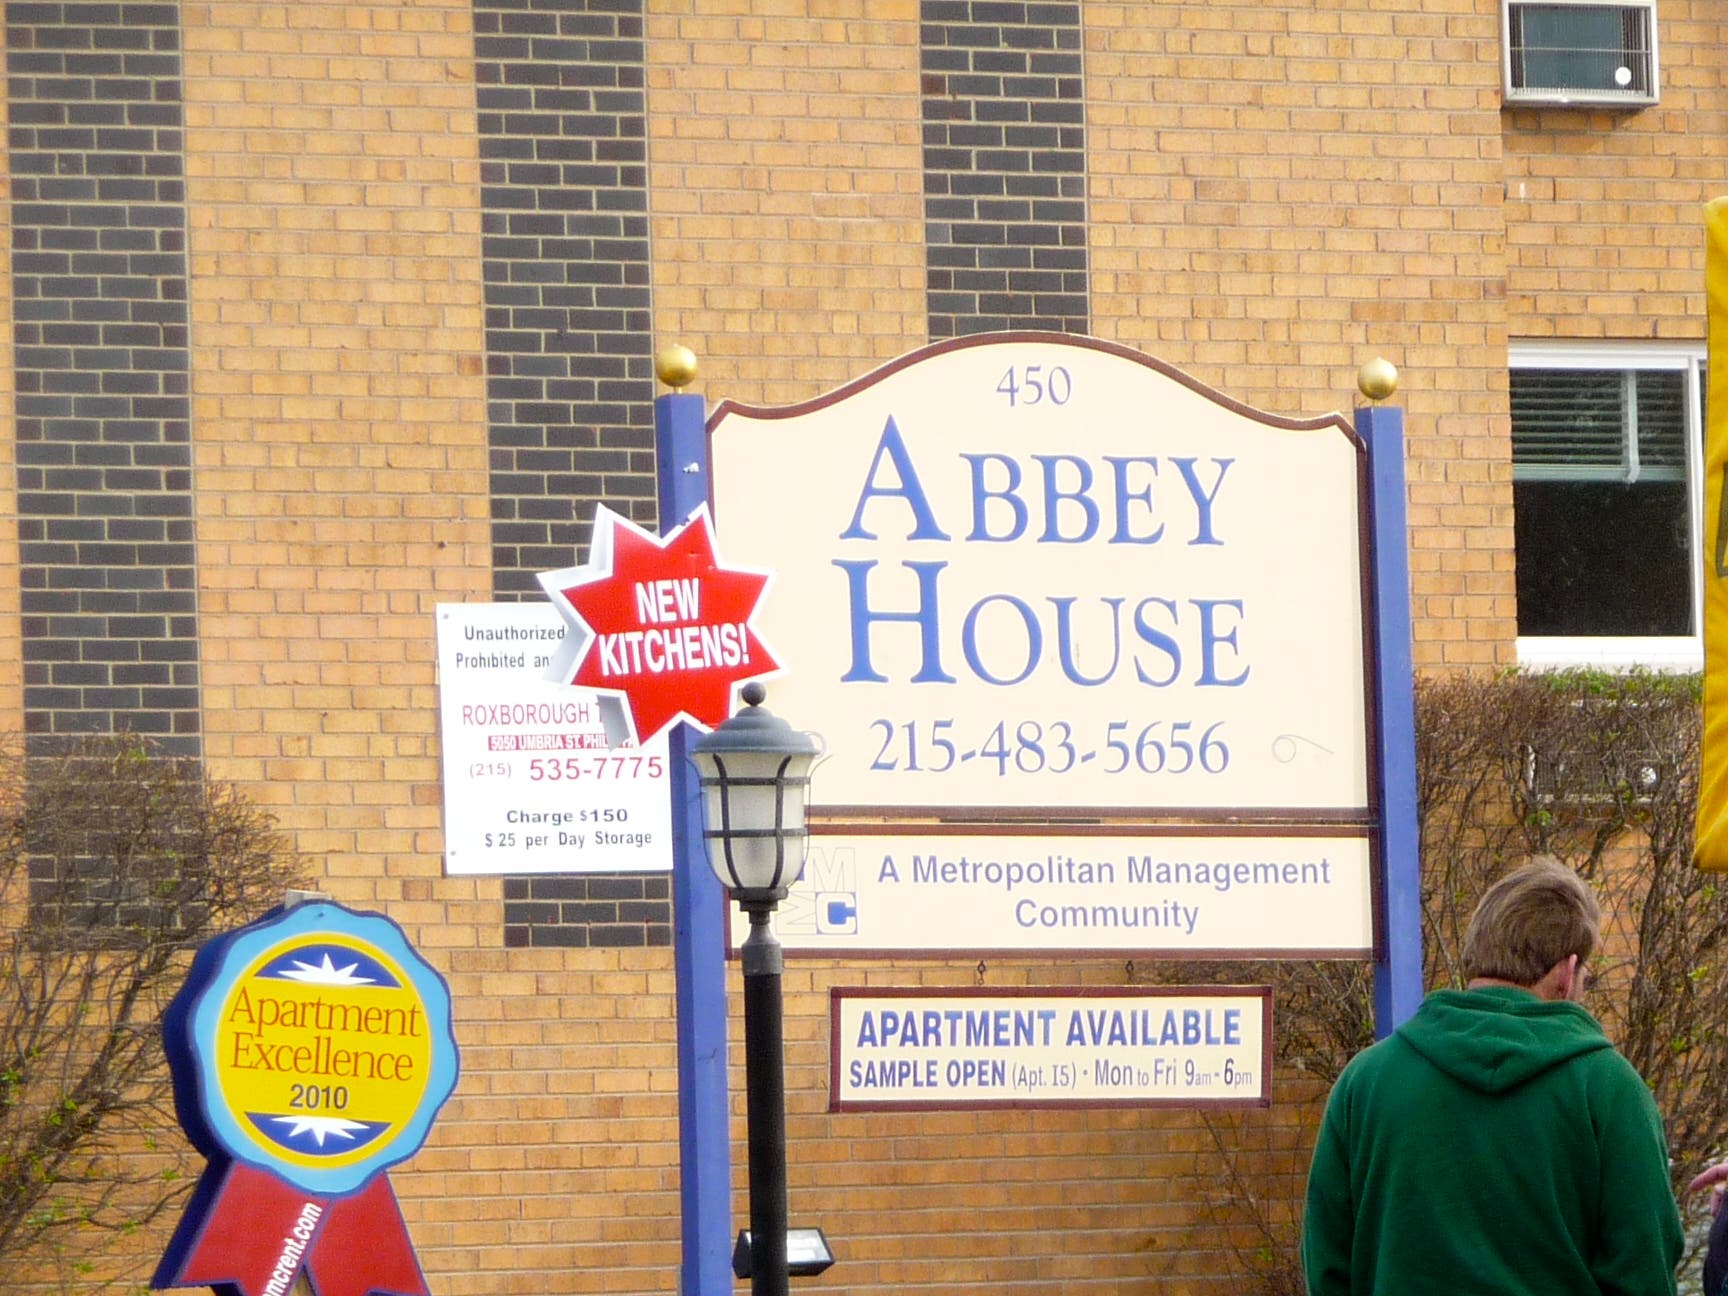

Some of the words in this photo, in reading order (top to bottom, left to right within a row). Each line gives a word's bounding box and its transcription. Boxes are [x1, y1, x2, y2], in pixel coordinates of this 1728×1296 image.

[997, 366, 1071, 406] 450
[634, 578, 701, 624] NEW
[464, 625, 565, 640] Unauthorized
[598, 622, 749, 676] KITCHENS!
[457, 653, 524, 668] Prohibited
[534, 655, 552, 667] an
[463, 704, 589, 725] ROXBOROUGH
[490, 736, 516, 750] 5050
[519, 735, 563, 749] UMBRIA
[870, 720, 1228, 776] 215-483-5656
[470, 763, 511, 778] (215)
[530, 757, 662, 780] 535-7775
[507, 811, 572, 826] Charge
[525, 835, 549, 850] per
[559, 832, 584, 848] Day
[596, 831, 651, 847] Storage
[878, 856, 899, 882] A
[913, 856, 1114, 890] Metropolitan
[1128, 856, 1330, 891] Management
[1016, 899, 1198, 934] Community
[229, 986, 422, 1038] Apartment
[857, 1011, 1056, 1047] APARTMENT
[1066, 1010, 1240, 1046] AVAILABLE
[230, 1032, 414, 1082] Excellence
[850, 1061, 937, 1087] SAMPLE
[947, 1060, 1005, 1087] OPEN
[1012, 1062, 1047, 1093] (Apt.
[1096, 1060, 1132, 1086] Mon
[1137, 1068, 1149, 1086] to
[1154, 1059, 1176, 1085] Fri
[289, 1084, 349, 1110] 2010
